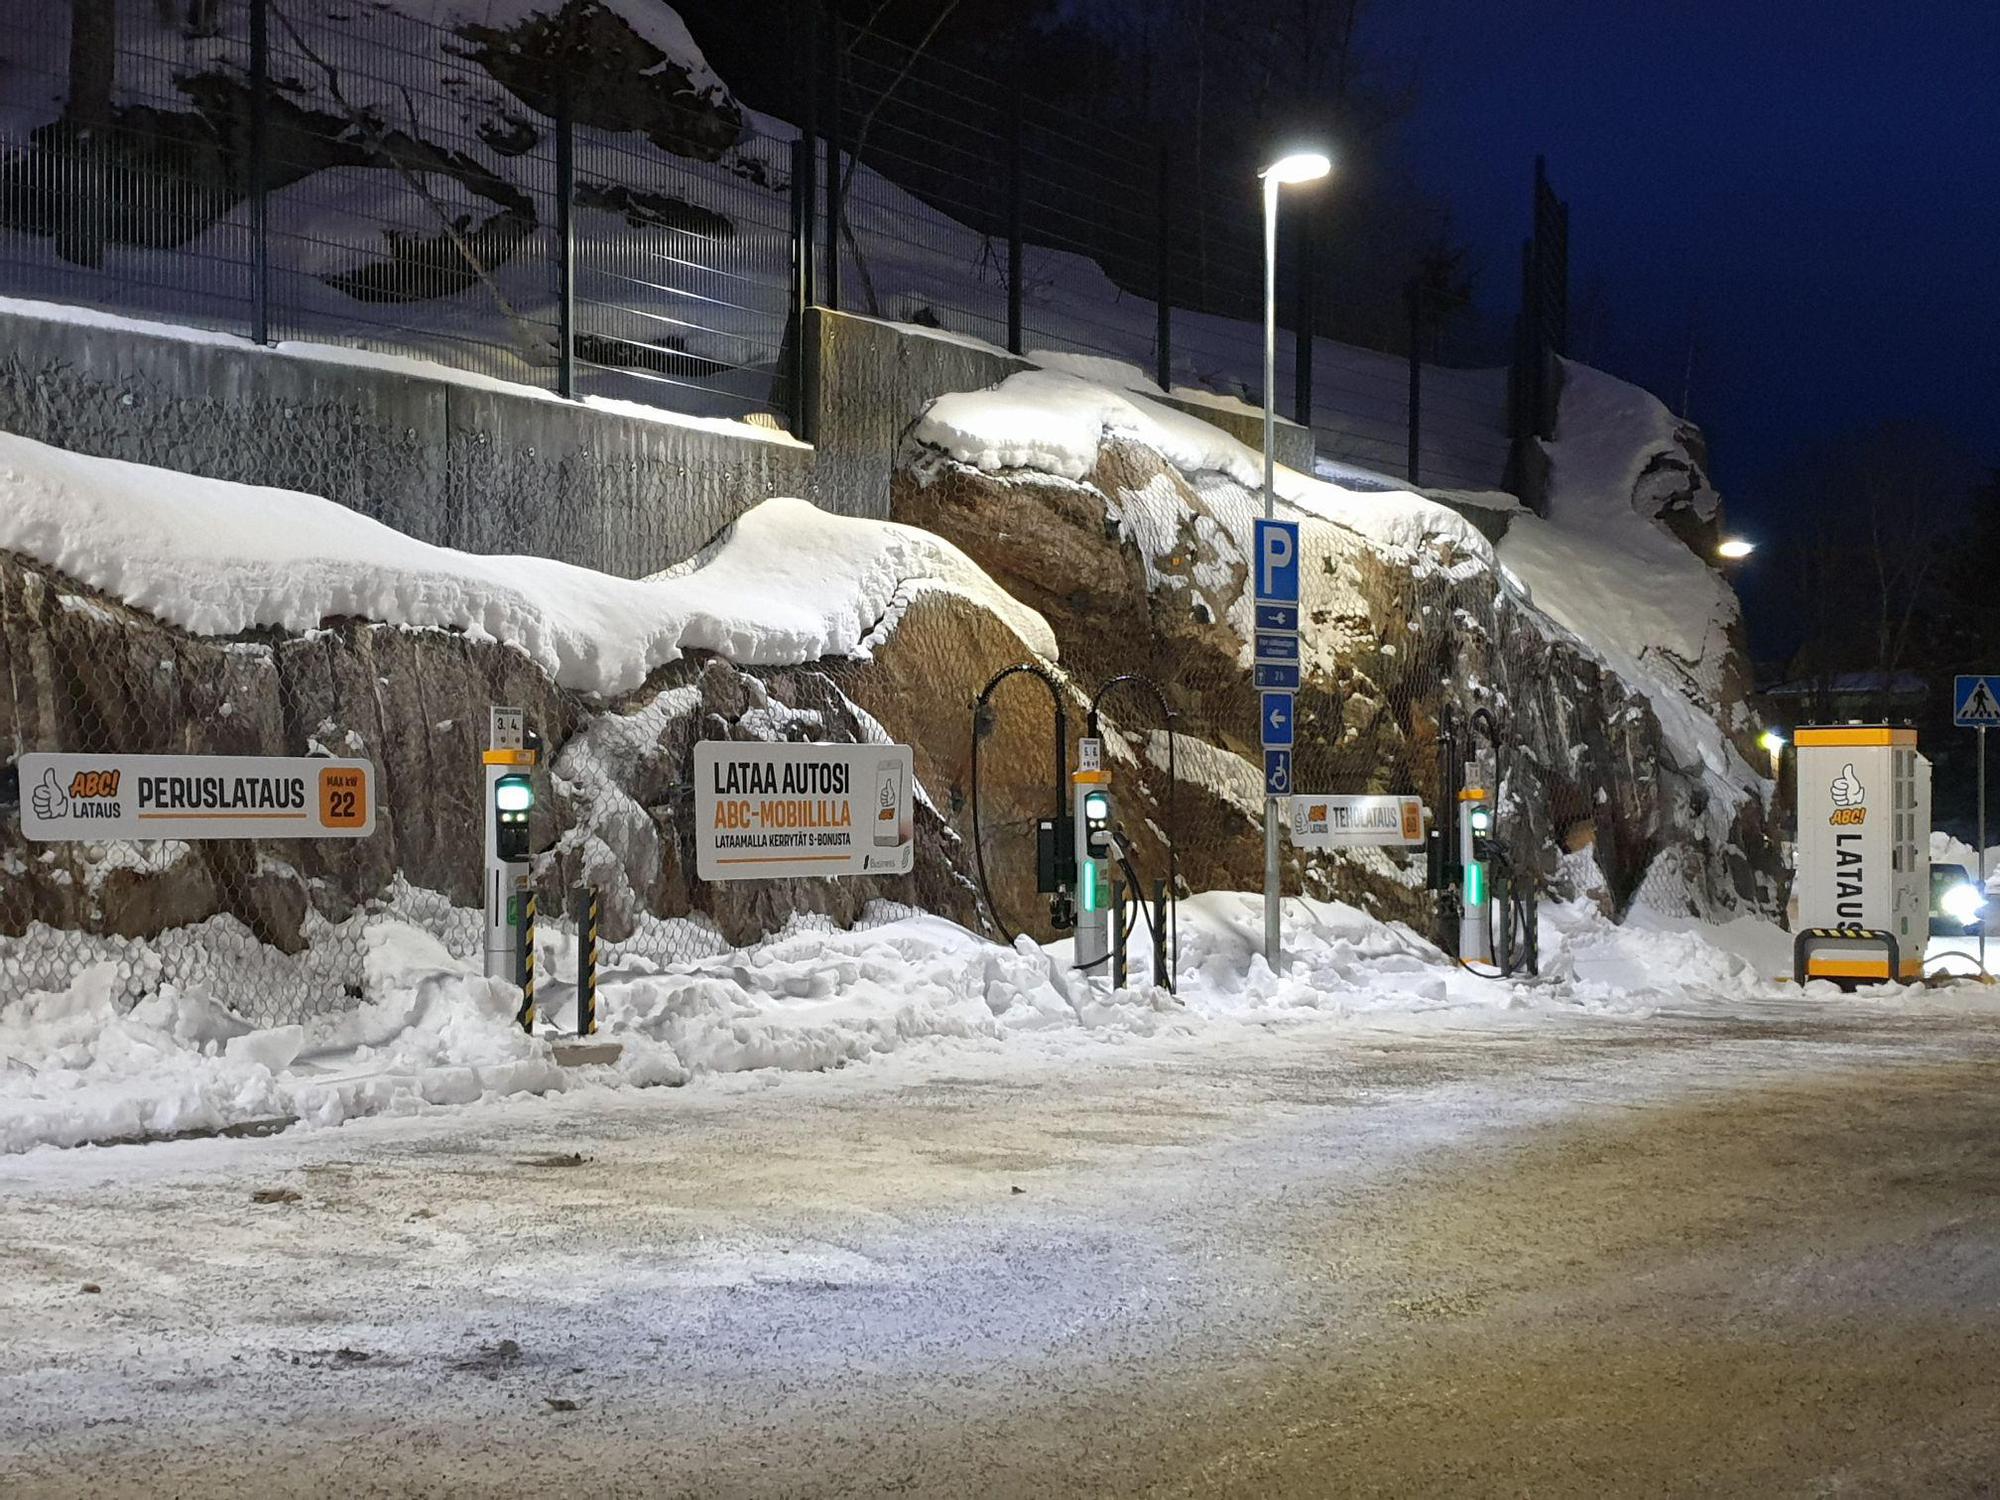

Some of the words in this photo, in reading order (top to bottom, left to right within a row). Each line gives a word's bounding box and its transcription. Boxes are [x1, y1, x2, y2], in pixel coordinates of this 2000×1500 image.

[1263, 526, 1293, 594] P
[69, 769, 120, 798] ABC!
[714, 762, 777, 794] LATAA
[782, 762, 850, 794] AUTOSI
[138, 777, 305, 809] PERUSLATAUS
[330, 791, 355, 817] 22
[73, 802, 121, 819] LATAUS
[715, 800, 851, 829] ABC-MOBIILILLA
[1829, 807, 1866, 825] ABC!
[715, 834, 767, 848] LATAAMALLA
[769, 831, 807, 847] KERRYTÄT
[809, 832, 851, 847] S-BONUSTA
